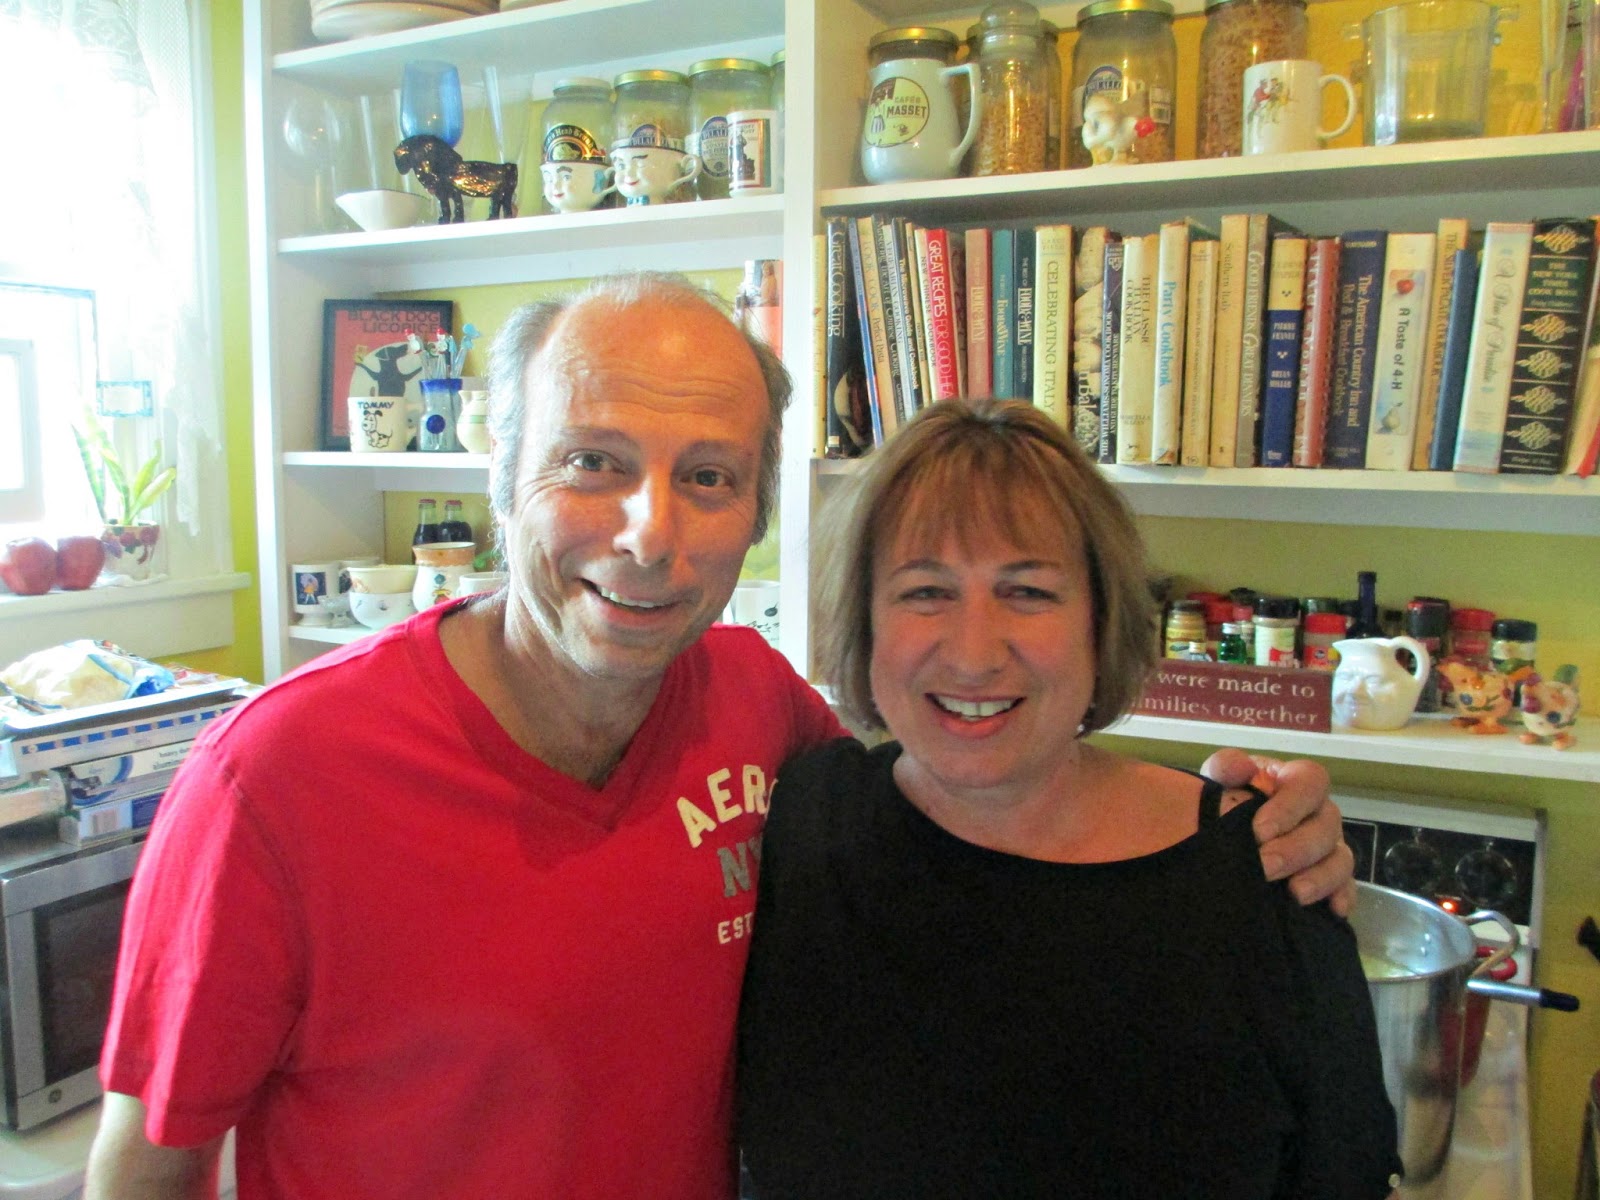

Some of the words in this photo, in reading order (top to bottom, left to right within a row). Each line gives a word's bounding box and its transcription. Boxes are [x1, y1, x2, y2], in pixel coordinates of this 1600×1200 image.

[886, 104, 927, 118] MASSET
[831, 232, 844, 270] Great
[899, 258, 907, 273] The
[928, 240, 943, 273] GREAT
[1222, 243, 1234, 287] Southern
[1248, 251, 1264, 287] GOOD
[1359, 275, 1373, 294] The
[828, 272, 844, 337] Cooking
[885, 240, 899, 297] VEGETARIAN
[894, 300, 903, 343] COOKING
[901, 274, 910, 314] Microwave
[932, 277, 947, 317] RECIPES
[1160, 281, 1177, 316] Party
[1220, 291, 1232, 312] Italy
[1342, 284, 1355, 303] Bed
[348, 310, 400, 322] BLACK
[405, 310, 439, 322] DOG
[904, 315, 913, 336] Guide
[922, 279, 931, 314] CHINESE
[927, 318, 936, 368] COOKBOOK
[1046, 260, 1058, 364] CELEBRATING
[1247, 288, 1260, 332] FRIENDS
[1354, 297, 1370, 345] American
[1398, 307, 1411, 317] A
[363, 322, 439, 334] LICORICE
[873, 317, 884, 343] Perfect
[907, 338, 915, 352] and
[935, 319, 947, 339] FOR
[1104, 311, 1112, 358] COOKBOOK
[1337, 319, 1352, 365] Breakfast
[1394, 321, 1410, 350] Taste
[877, 344, 885, 363] Pasta
[890, 343, 901, 378] Cooking
[937, 340, 952, 374] GOOD
[1158, 322, 1177, 387] Cookbook
[1242, 332, 1259, 370] GREAT
[1348, 347, 1365, 388] Country
[1393, 354, 1407, 366] of
[909, 353, 919, 389] Cookbook
[940, 376, 954, 399] HEA
[1391, 369, 1405, 391] 4-H
[357, 401, 394, 410] TOMMY
[1043, 370, 1057, 412] ITALY
[1078, 384, 1096, 429] Baker
[1100, 358, 1112, 438] WILLIAMS-SONOMA
[1240, 374, 1252, 417] DINNERS
[1333, 368, 1347, 416] Cookbook
[1350, 390, 1362, 406] Inn
[1347, 408, 1359, 427] and
[1100, 439, 1109, 456] THE
[1157, 671, 1207, 689] were
[1218, 677, 1282, 695] made
[1291, 684, 1315, 698] to
[1219, 702, 1318, 725] together
[677, 764, 772, 848] AER
